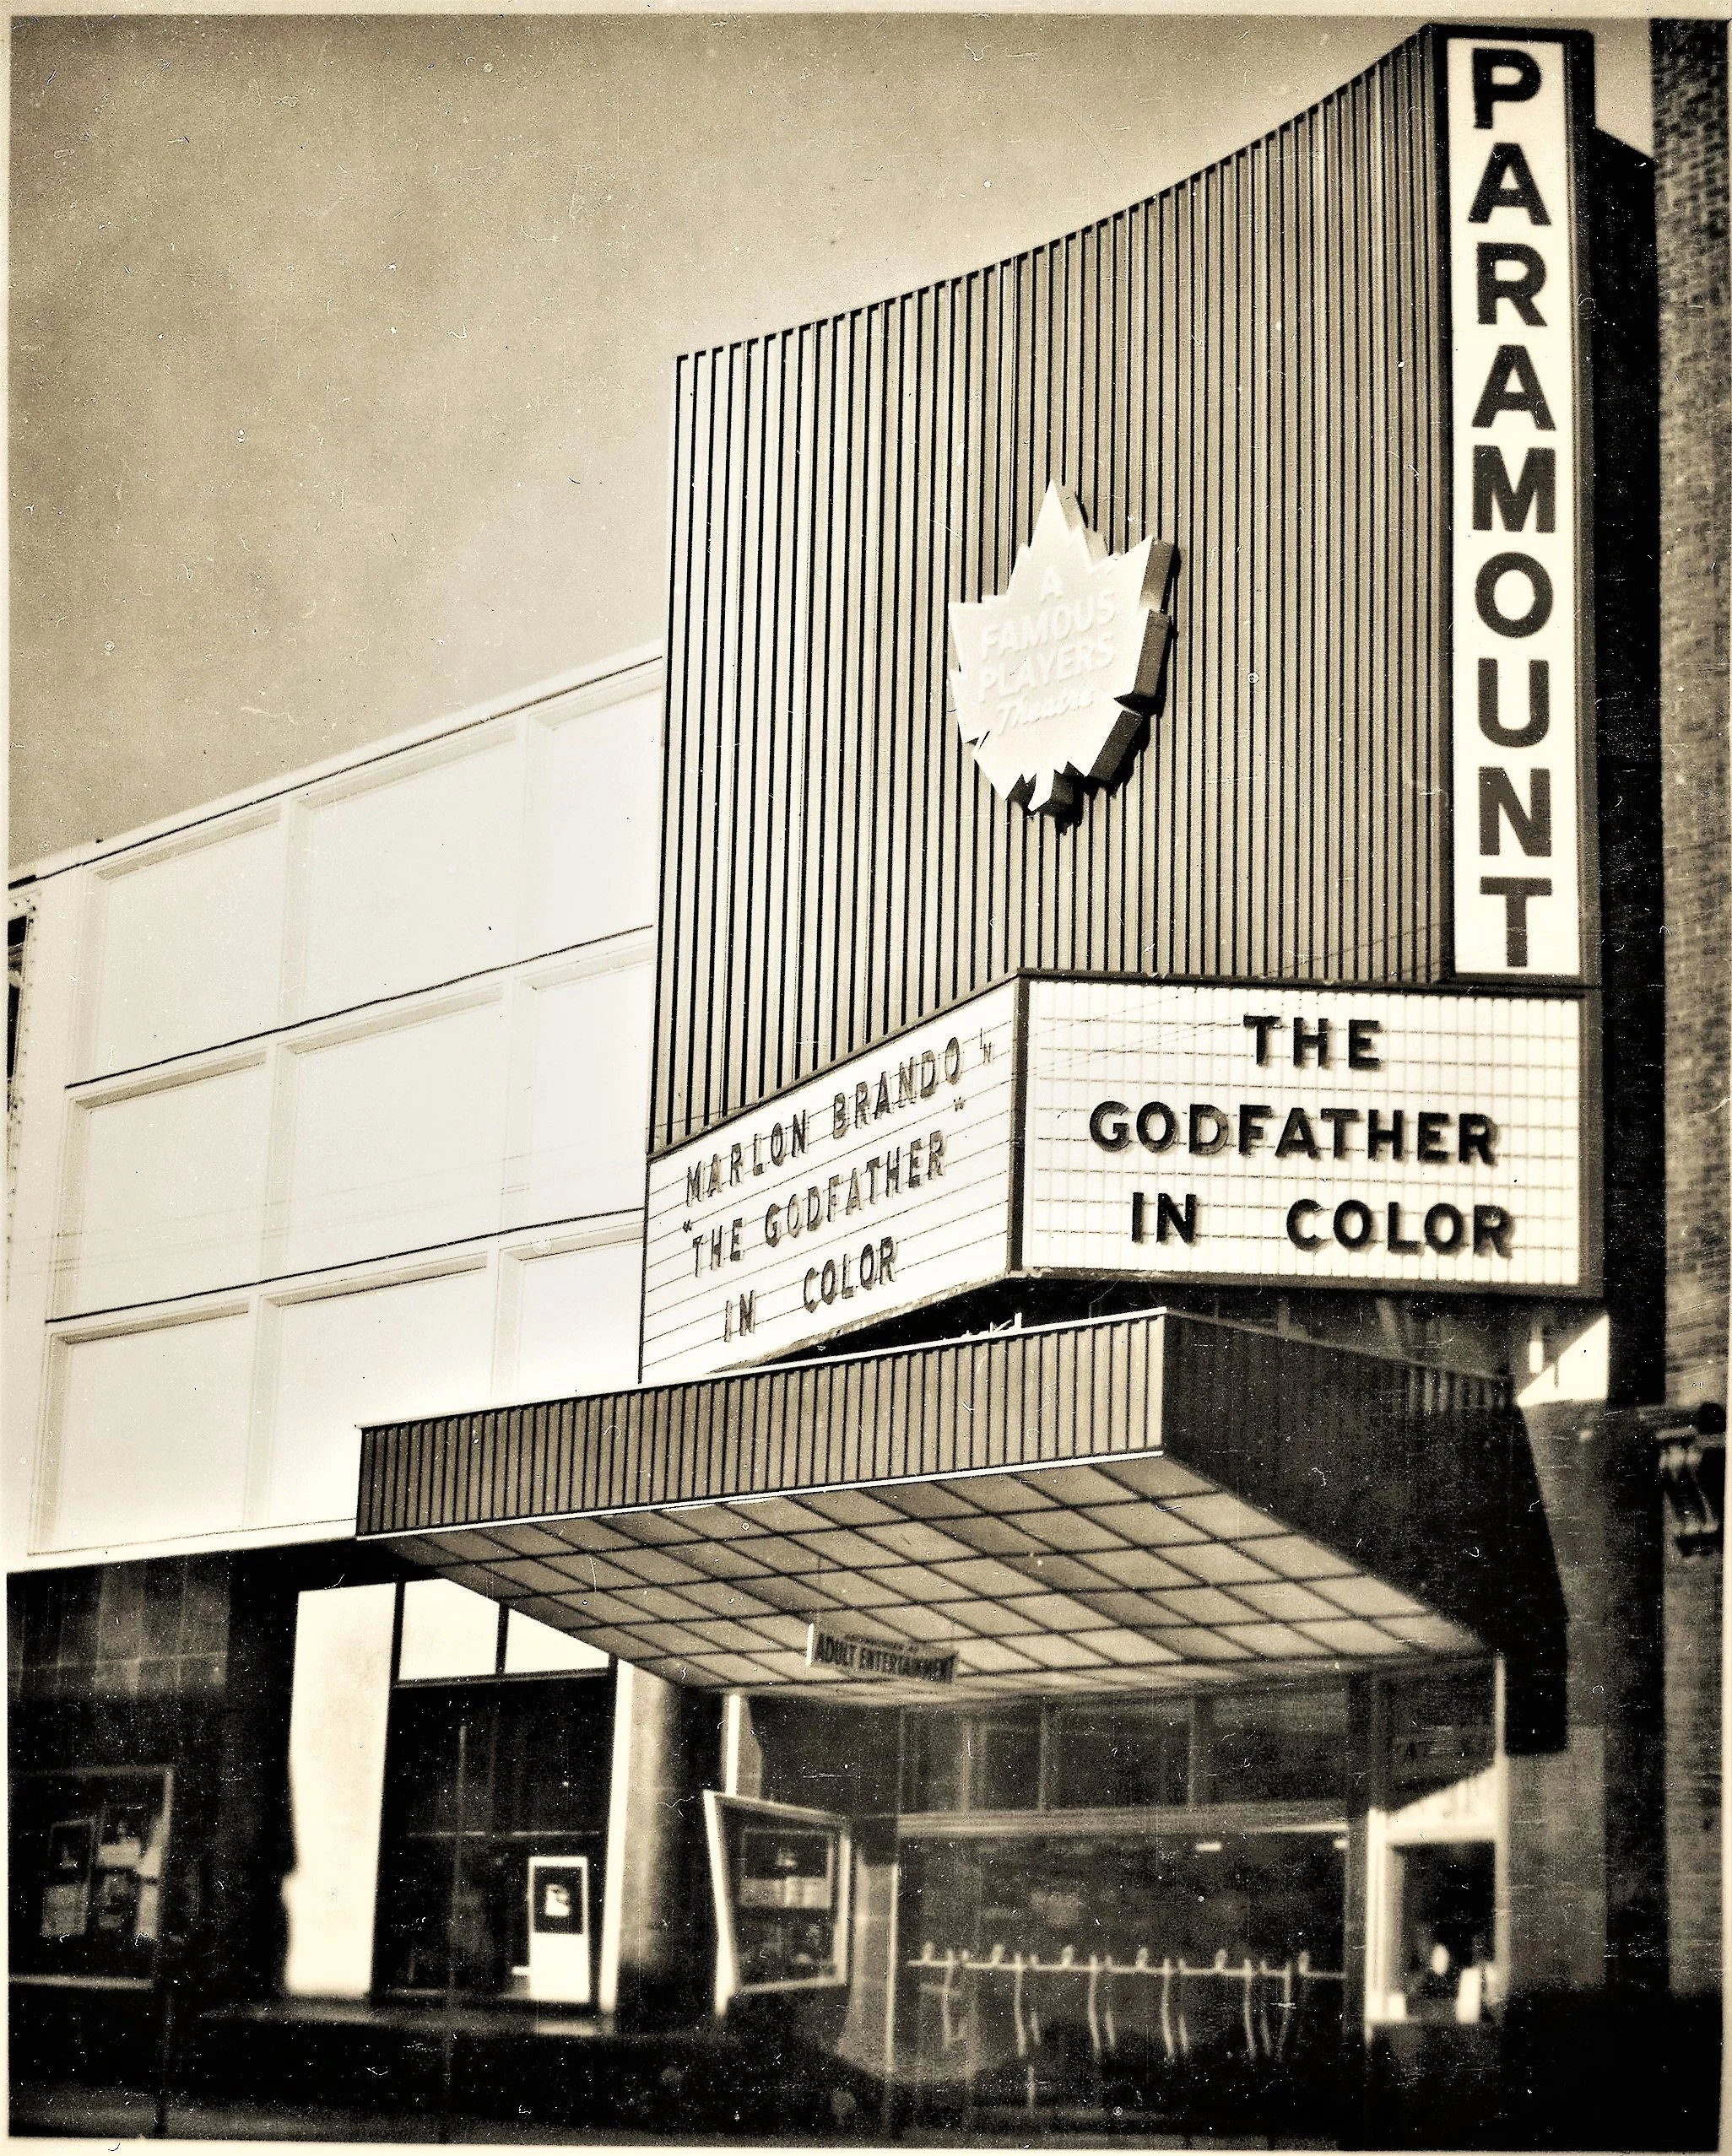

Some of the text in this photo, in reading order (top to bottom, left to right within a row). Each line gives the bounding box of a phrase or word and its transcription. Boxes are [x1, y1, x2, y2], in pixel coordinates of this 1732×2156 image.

[1466, 46, 1557, 969] PARAMOUNT
[1039, 564, 1064, 605] A
[981, 586, 1115, 663] FAMOUS
[980, 630, 1114, 704] PLAYERS
[1242, 1014, 1383, 1070] THE
[686, 1109, 809, 1207] MARLON
[833, 1036, 961, 1139] BRANDO
[1089, 1100, 1500, 1167] GODFATHER
[1130, 1191, 1513, 1258] IN COLOR
[724, 1235, 898, 1343] IN COLOR
[814, 1631, 858, 1667] ADULT
